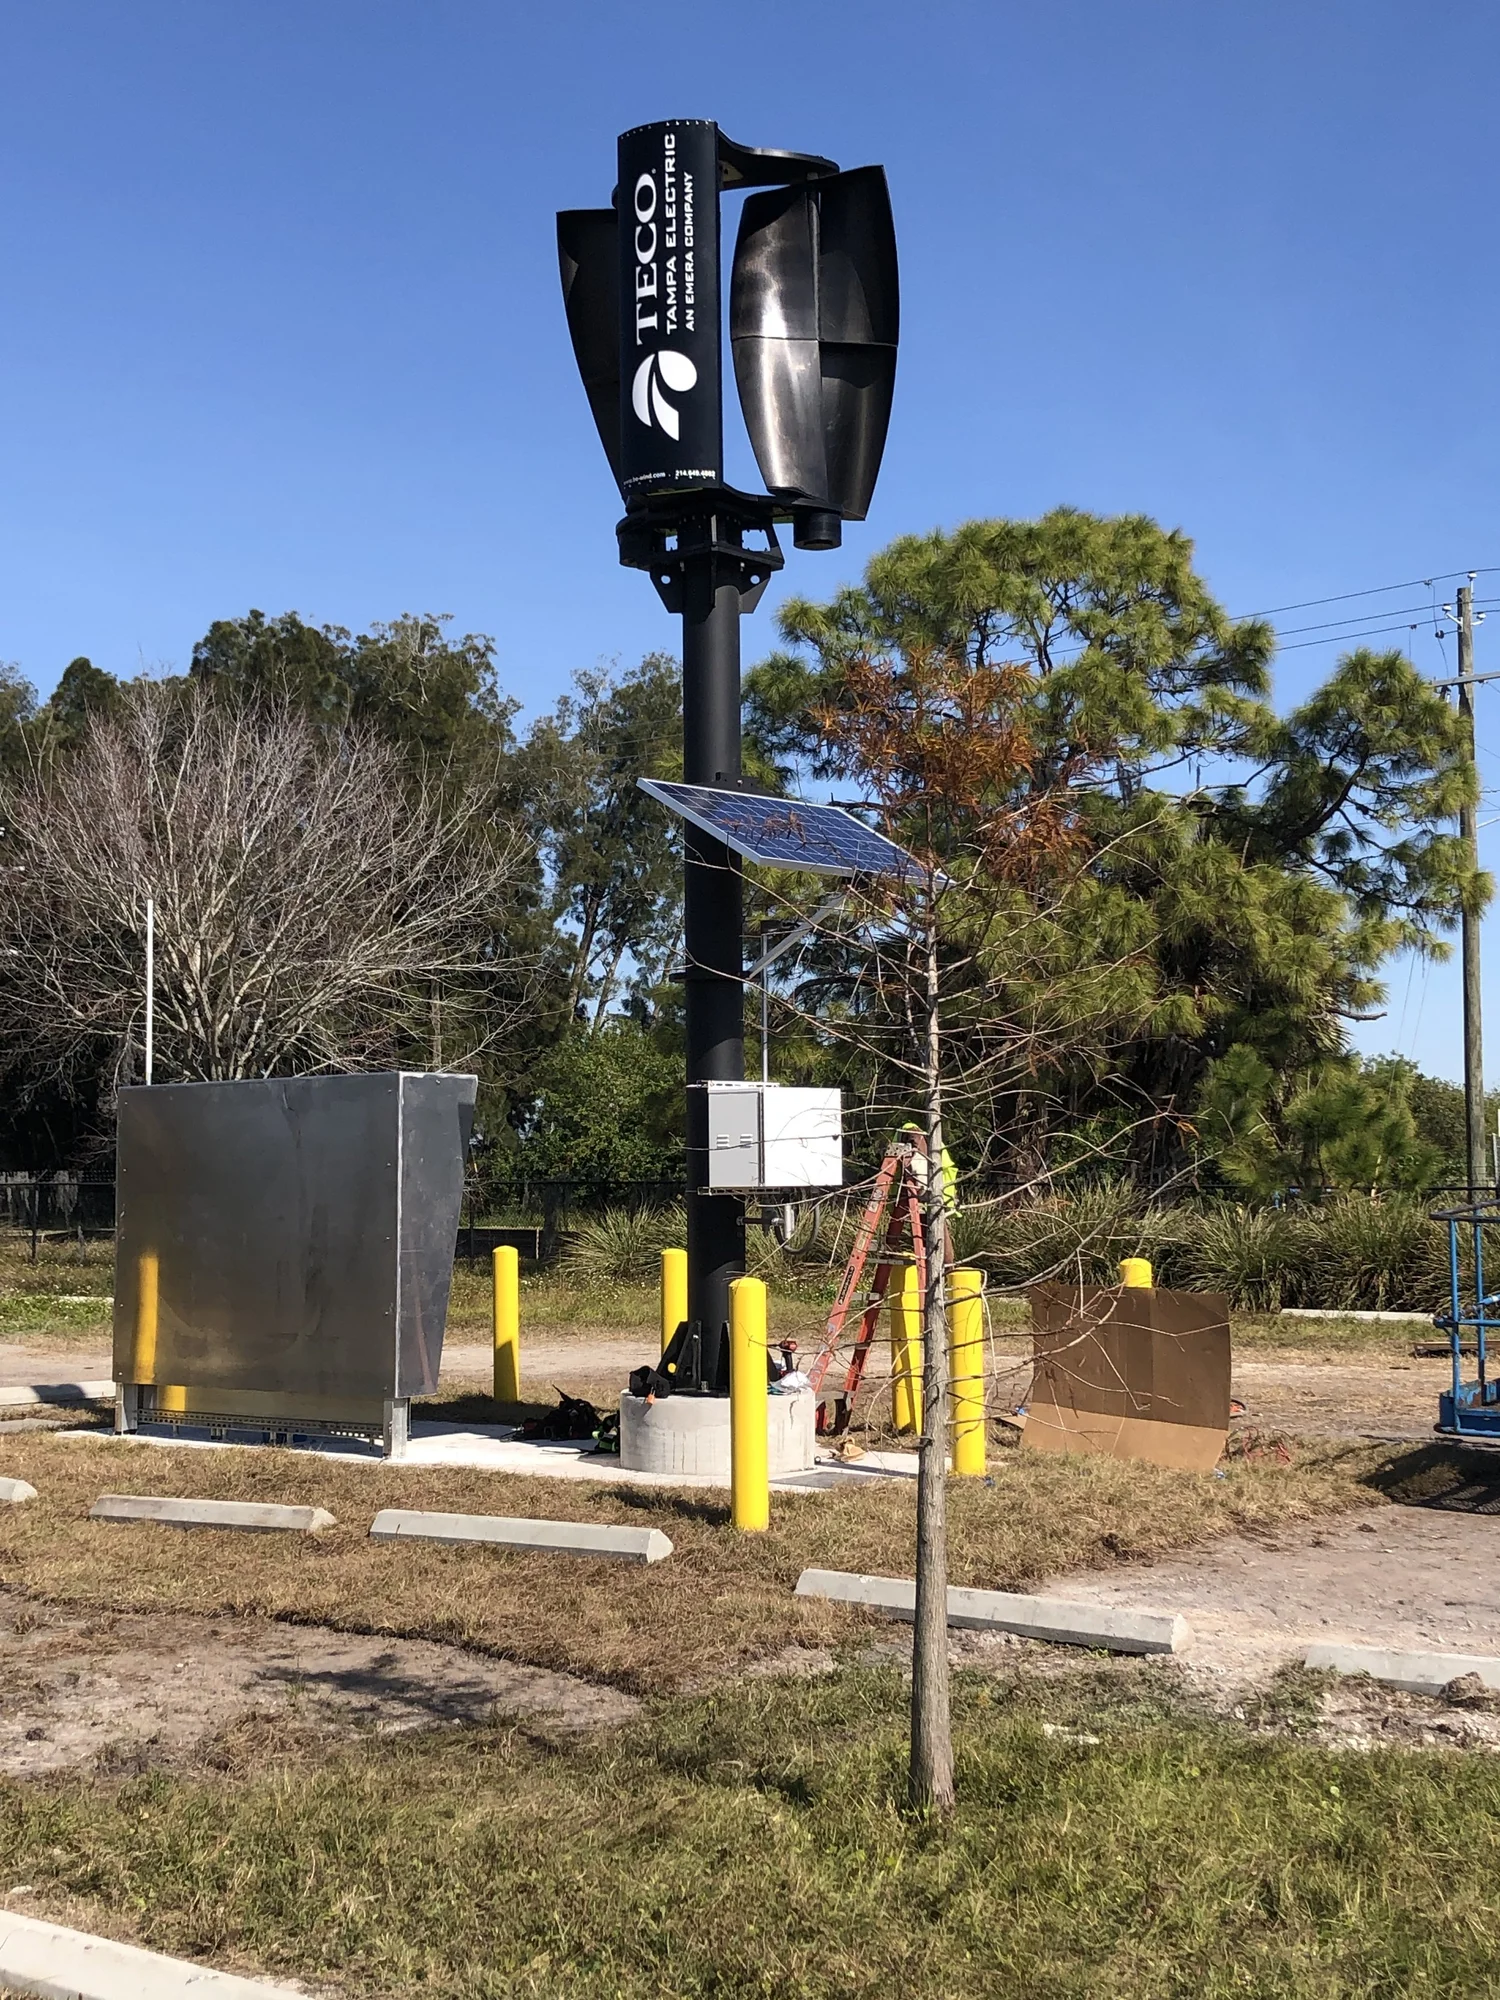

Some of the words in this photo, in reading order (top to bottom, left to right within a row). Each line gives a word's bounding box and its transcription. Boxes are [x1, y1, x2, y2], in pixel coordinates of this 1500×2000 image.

[664, 133, 676, 248] ELECTRIC
[683, 171, 694, 247] COMPANY
[635, 173, 658, 346] TECO
[666, 255, 677, 335] TAMPA
[684, 251, 694, 305] EMERA
[685, 309, 694, 332] AN
